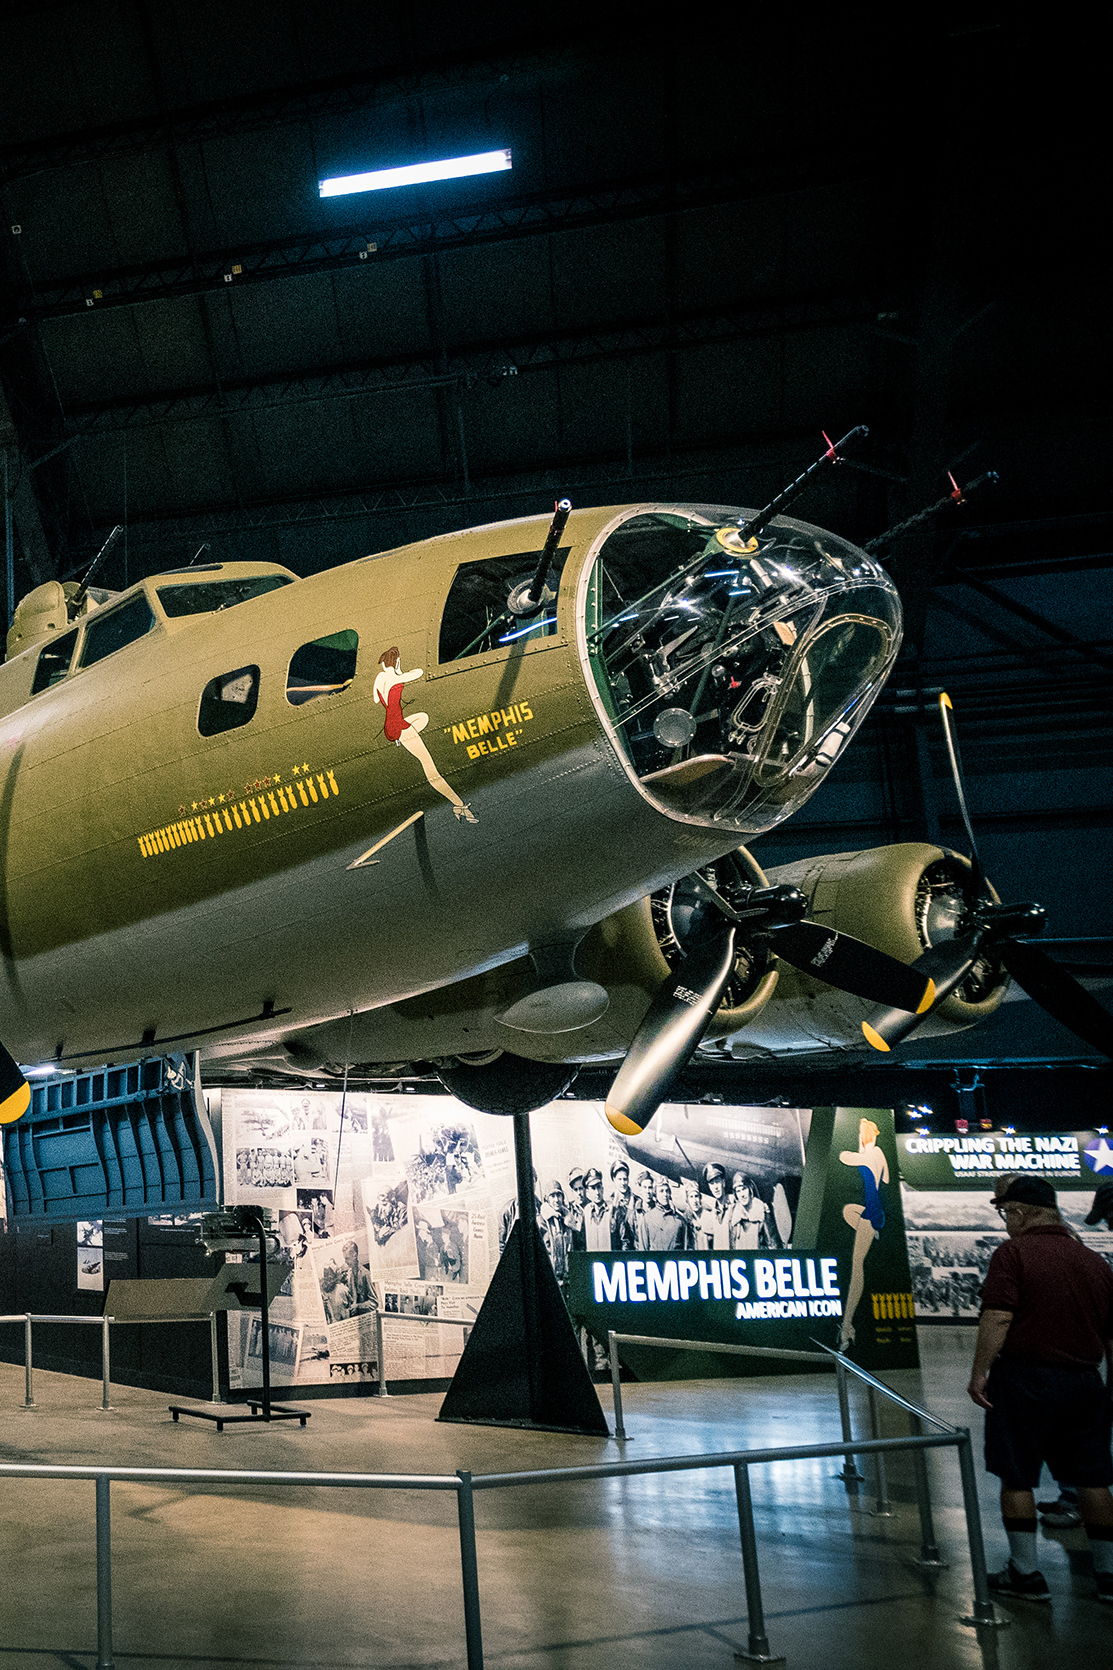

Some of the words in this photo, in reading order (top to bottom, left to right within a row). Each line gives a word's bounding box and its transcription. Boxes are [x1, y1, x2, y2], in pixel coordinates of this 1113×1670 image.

[443, 701, 534, 744] "MEMPHIS
[466, 728, 523, 760] BELLE"
[905, 1137, 995, 1154] CRIPPLING
[997, 1137, 1032, 1152] THE
[1035, 1136, 1079, 1152] NAZI
[950, 1154, 994, 1170] WAR
[995, 1154, 1081, 1170] MACHINE
[592, 1258, 750, 1303] MEMPHIS
[754, 1258, 840, 1298] BELLE
[736, 1301, 808, 1319] AMERICAN
[809, 1300, 843, 1317] ICON
